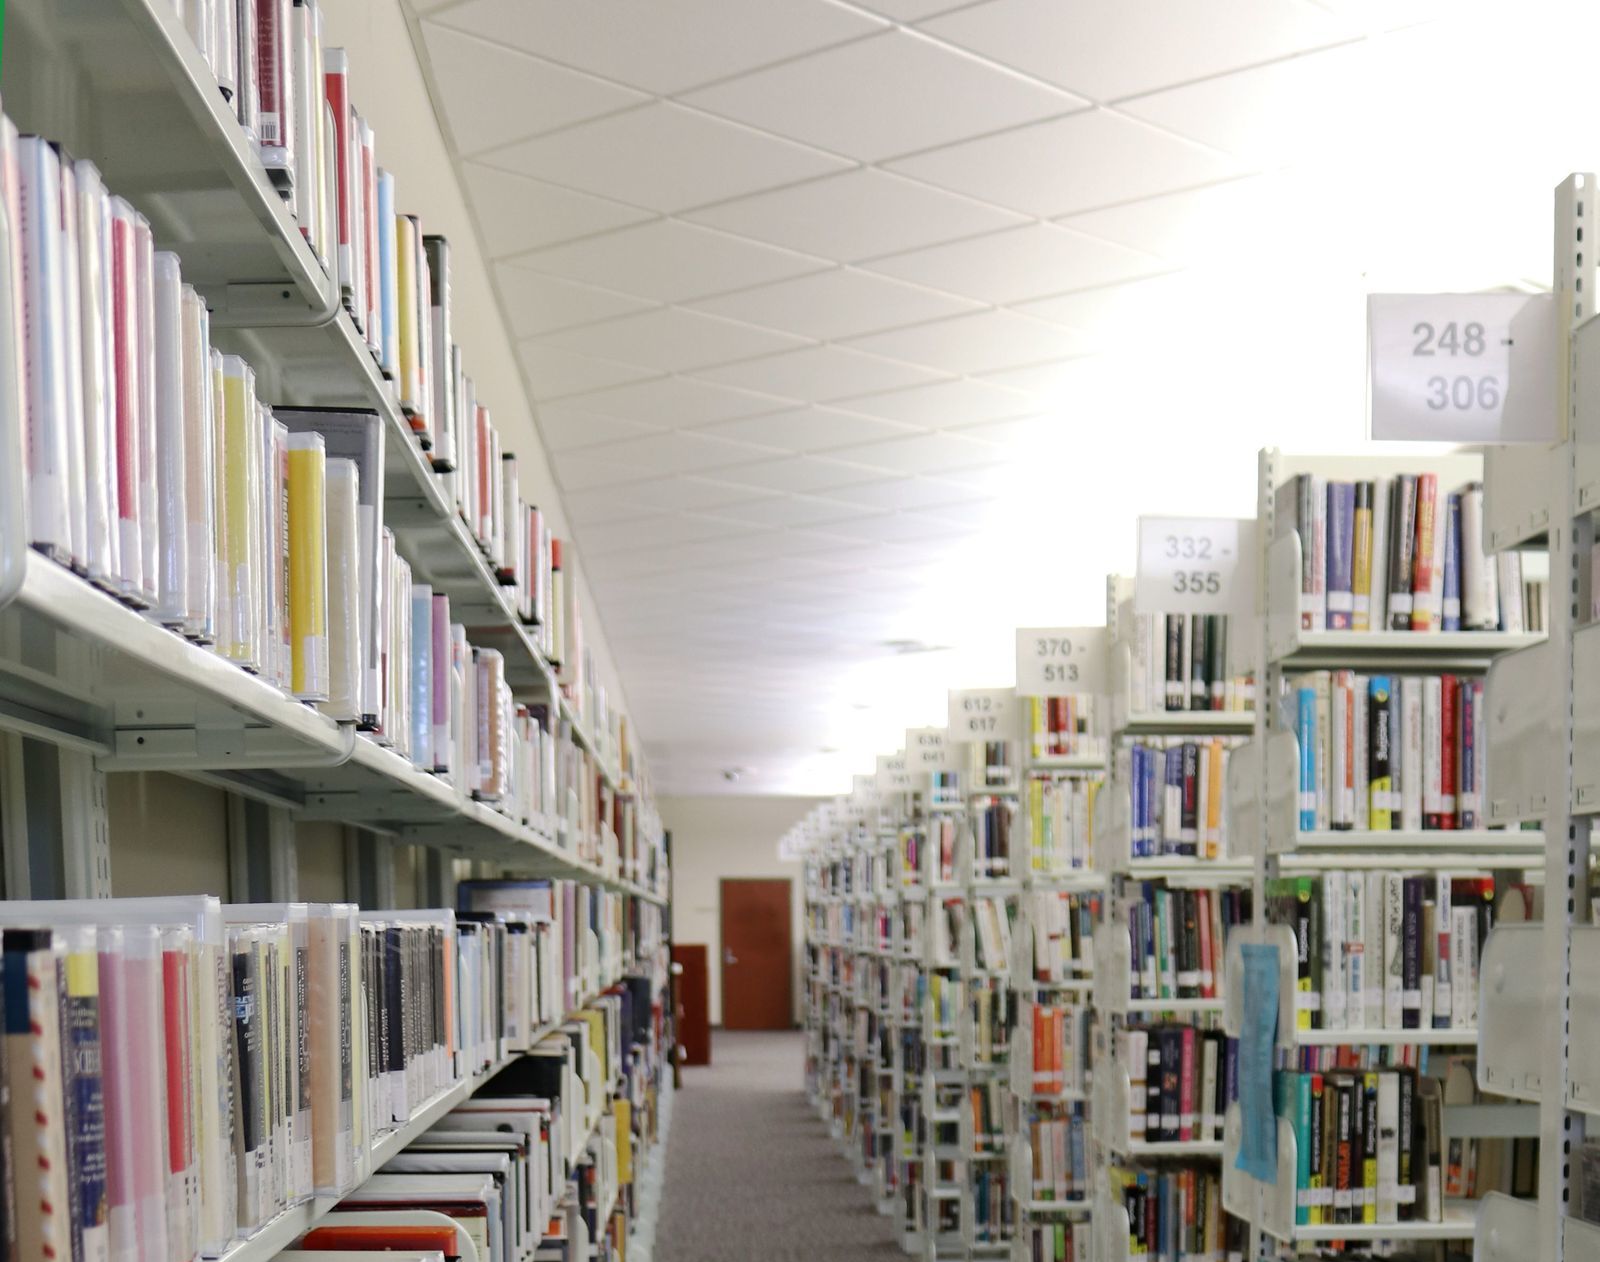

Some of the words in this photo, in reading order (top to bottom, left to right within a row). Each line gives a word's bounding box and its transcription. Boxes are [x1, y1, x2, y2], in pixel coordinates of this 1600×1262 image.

[1412, 321, 1487, 357] 248
[1426, 375, 1500, 411] 306
[1165, 535, 1213, 559] 332
[1173, 570, 1221, 594] 355
[1036, 638, 1072, 656] 370
[1044, 664, 1079, 682] 513
[964, 697, 992, 711] 612
[970, 717, 997, 731] 617
